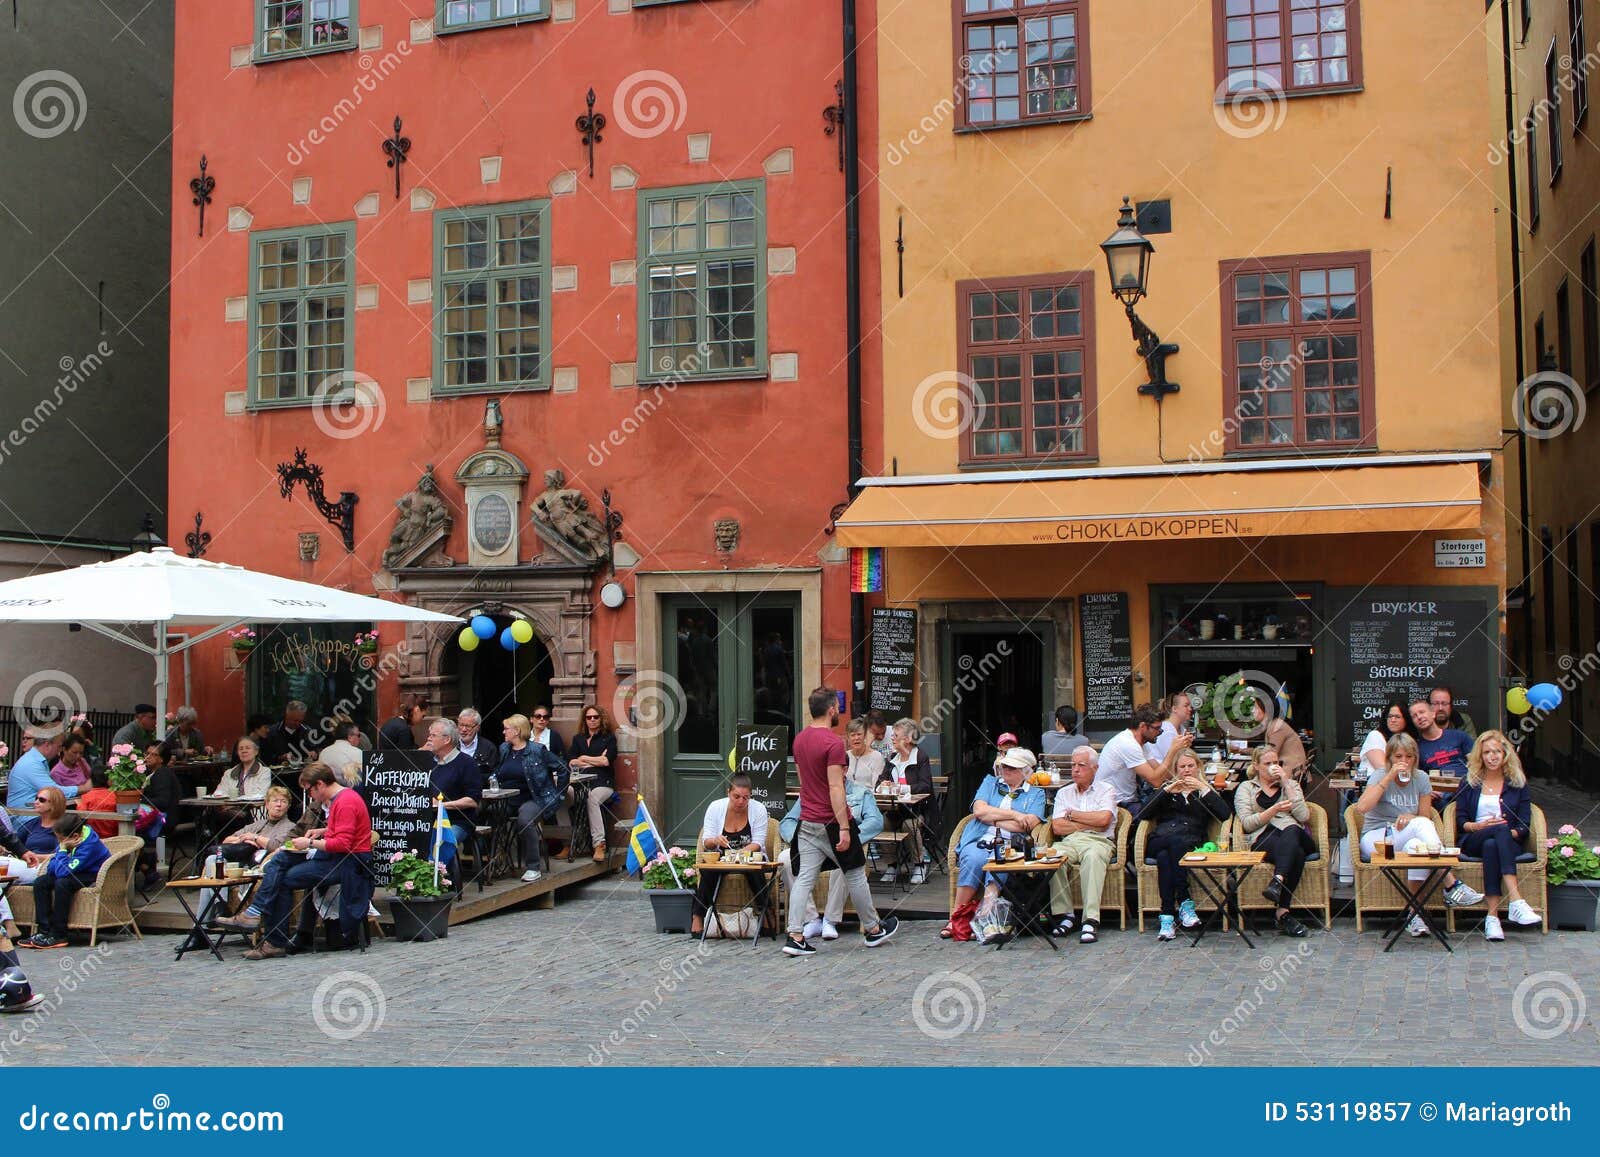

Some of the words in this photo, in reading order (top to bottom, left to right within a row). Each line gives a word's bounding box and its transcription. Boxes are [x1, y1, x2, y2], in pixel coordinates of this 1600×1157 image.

[1441, 542, 1483, 551] Stortorget
[1458, 556, 1484, 566] 20-18
[1086, 594, 1118, 603] DRINKS
[1372, 602, 1438, 615] DRYCKER
[1370, 666, 1436, 678] SÖTSAKER
[1088, 676, 1125, 686] SWEETS
[740, 732, 779, 752] TAKE
[741, 756, 781, 778] AWAY
[372, 817, 414, 833] HEMLAGAD
[416, 820, 430, 832] PAJ
